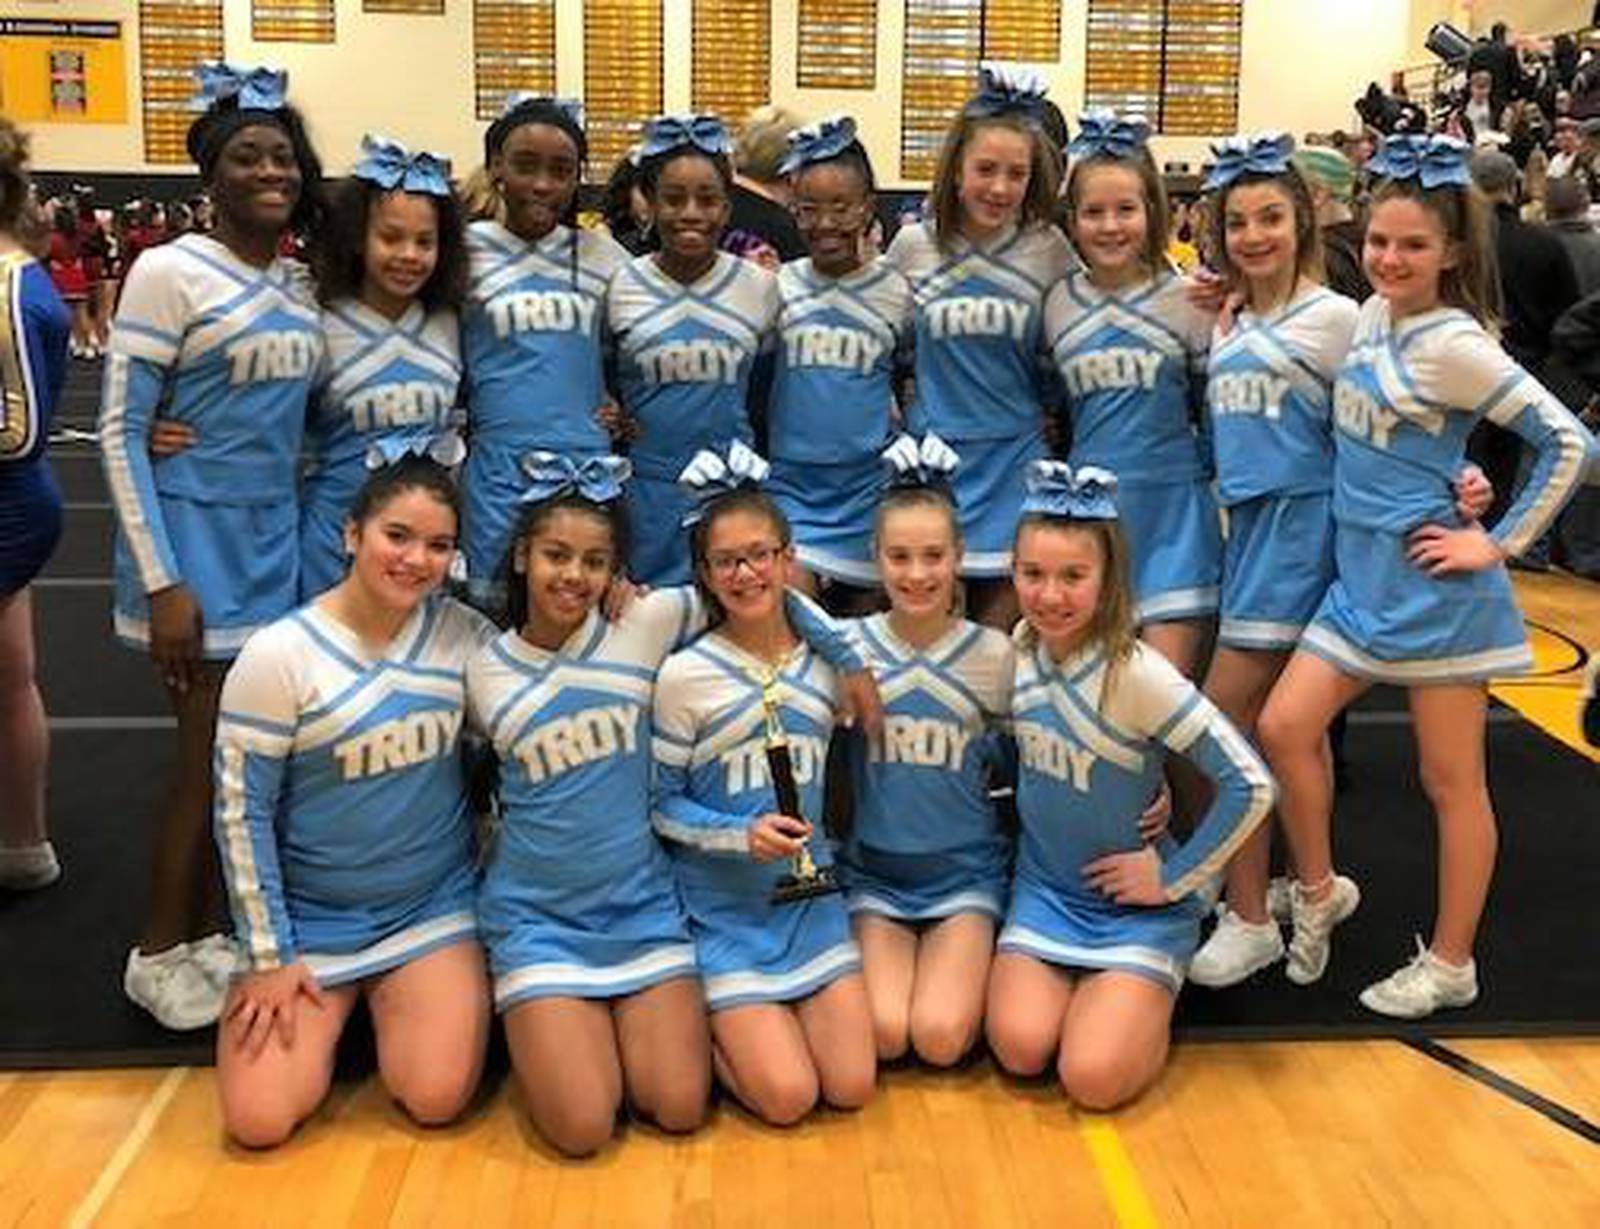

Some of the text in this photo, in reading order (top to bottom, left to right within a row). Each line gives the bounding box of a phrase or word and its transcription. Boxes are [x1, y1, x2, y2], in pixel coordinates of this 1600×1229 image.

[485, 291, 596, 337] TROY
[925, 300, 1031, 340] TROY
[634, 340, 745, 385] TROY
[785, 325, 883, 375] TROY
[1062, 348, 1164, 397] TROY
[515, 704, 640, 784] TROY
